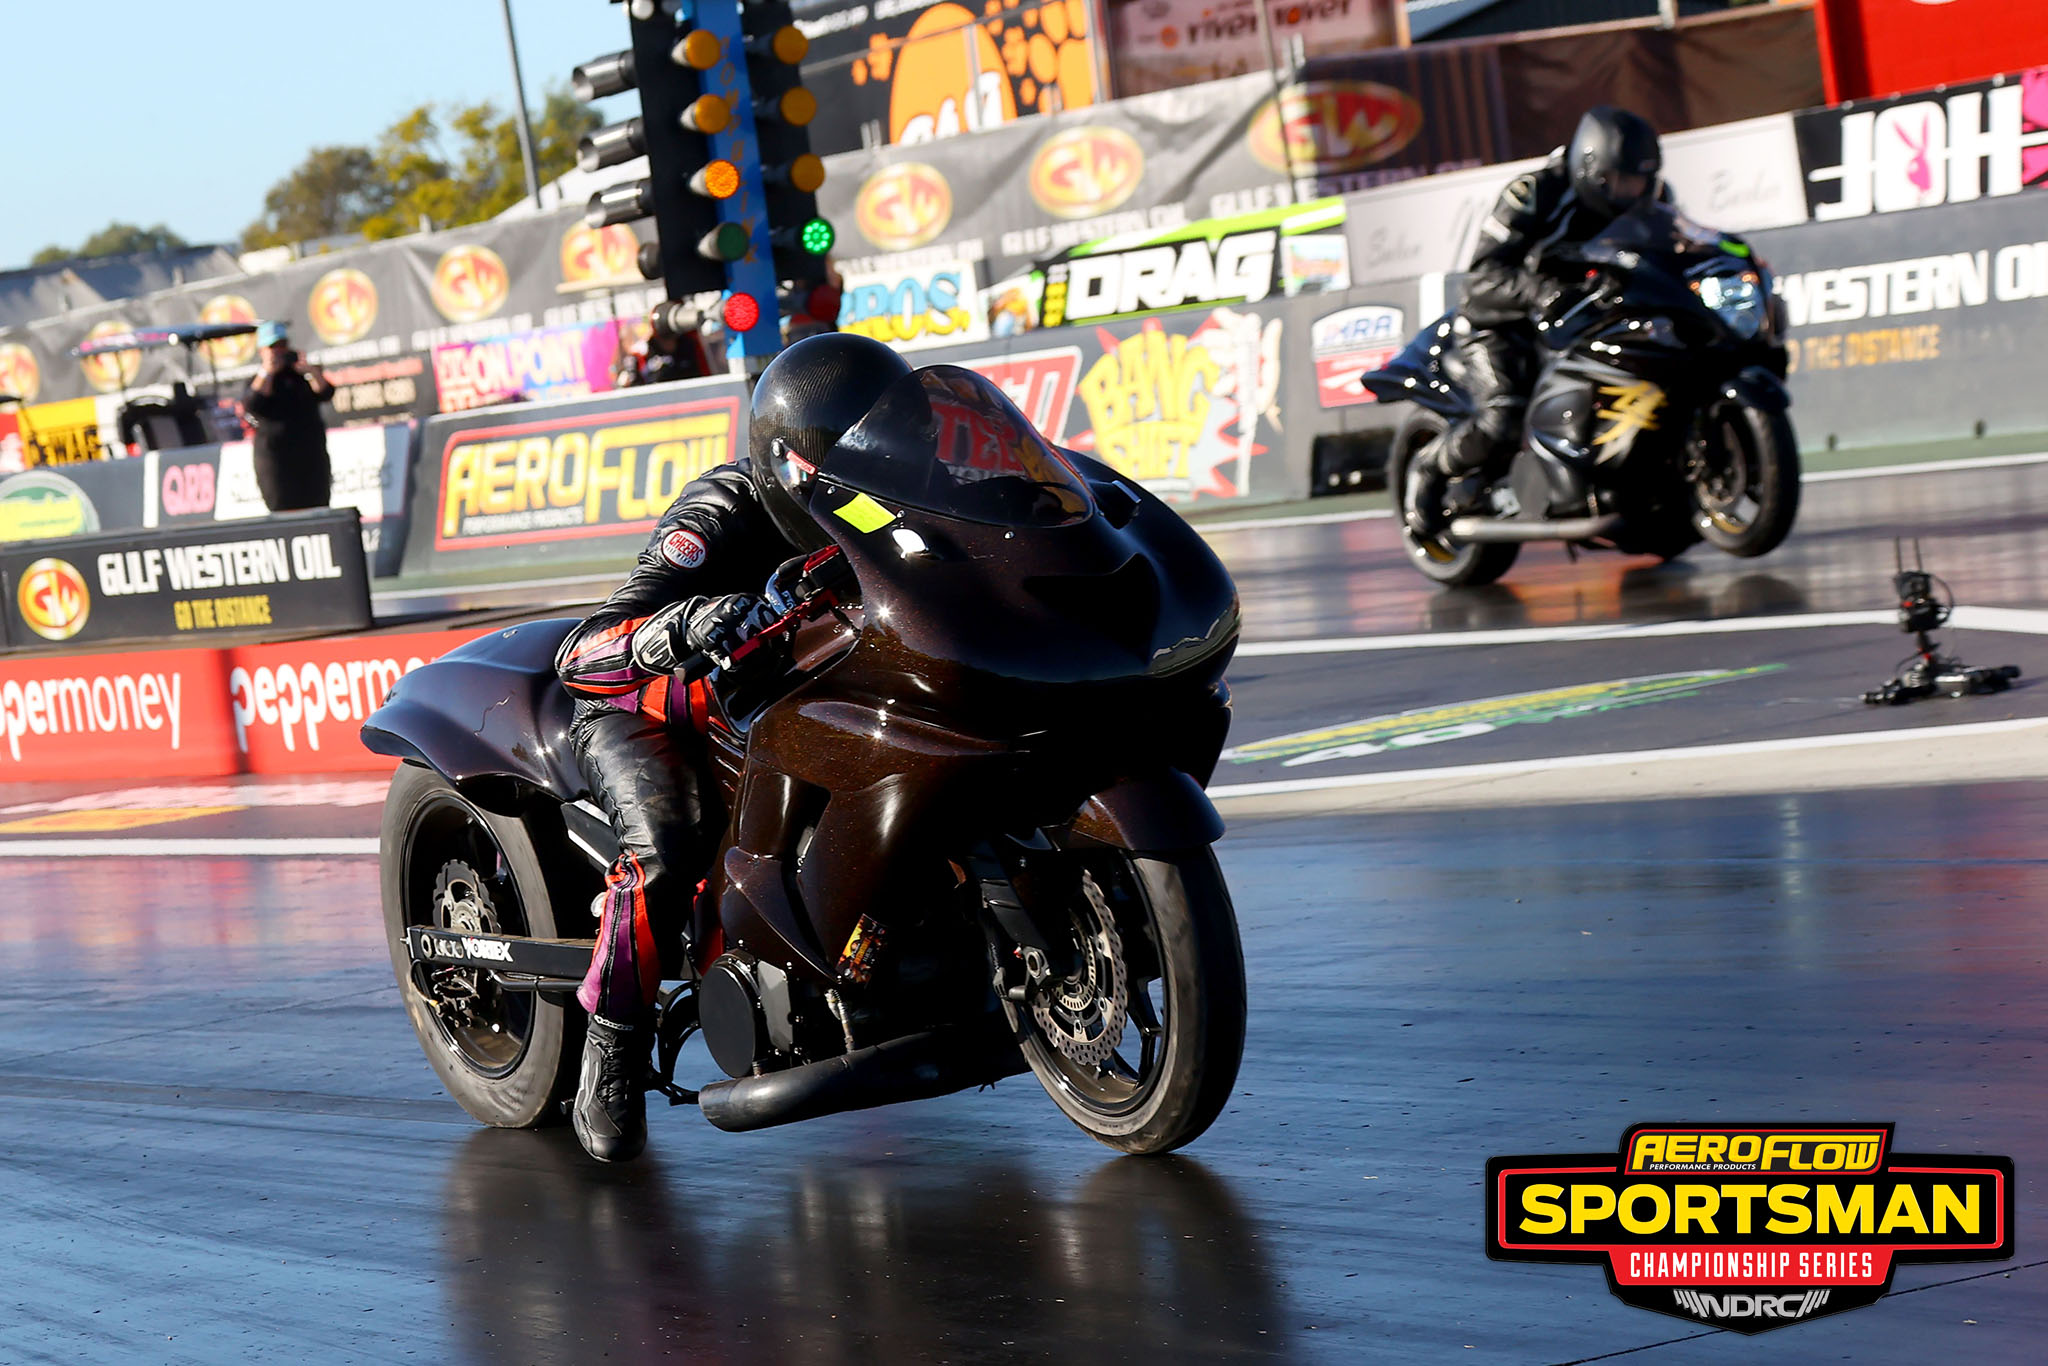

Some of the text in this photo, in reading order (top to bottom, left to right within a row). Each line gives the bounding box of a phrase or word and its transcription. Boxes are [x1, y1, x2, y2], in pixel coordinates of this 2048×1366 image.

[838, 272, 966, 342] ROS
[1065, 230, 1277, 321] DRAG
[1078, 331, 1222, 426] BANG
[442, 412, 730, 538] AEROFLOW
[1097, 420, 1202, 479] SHIFT
[97, 549, 164, 597] GULF
[163, 538, 290, 591] WESTERN
[291, 533, 343, 581] OIL
[668, 532, 704, 562] CHEERS
[0, 672, 181, 762] permoney
[461, 936, 514, 962] VORTEX
